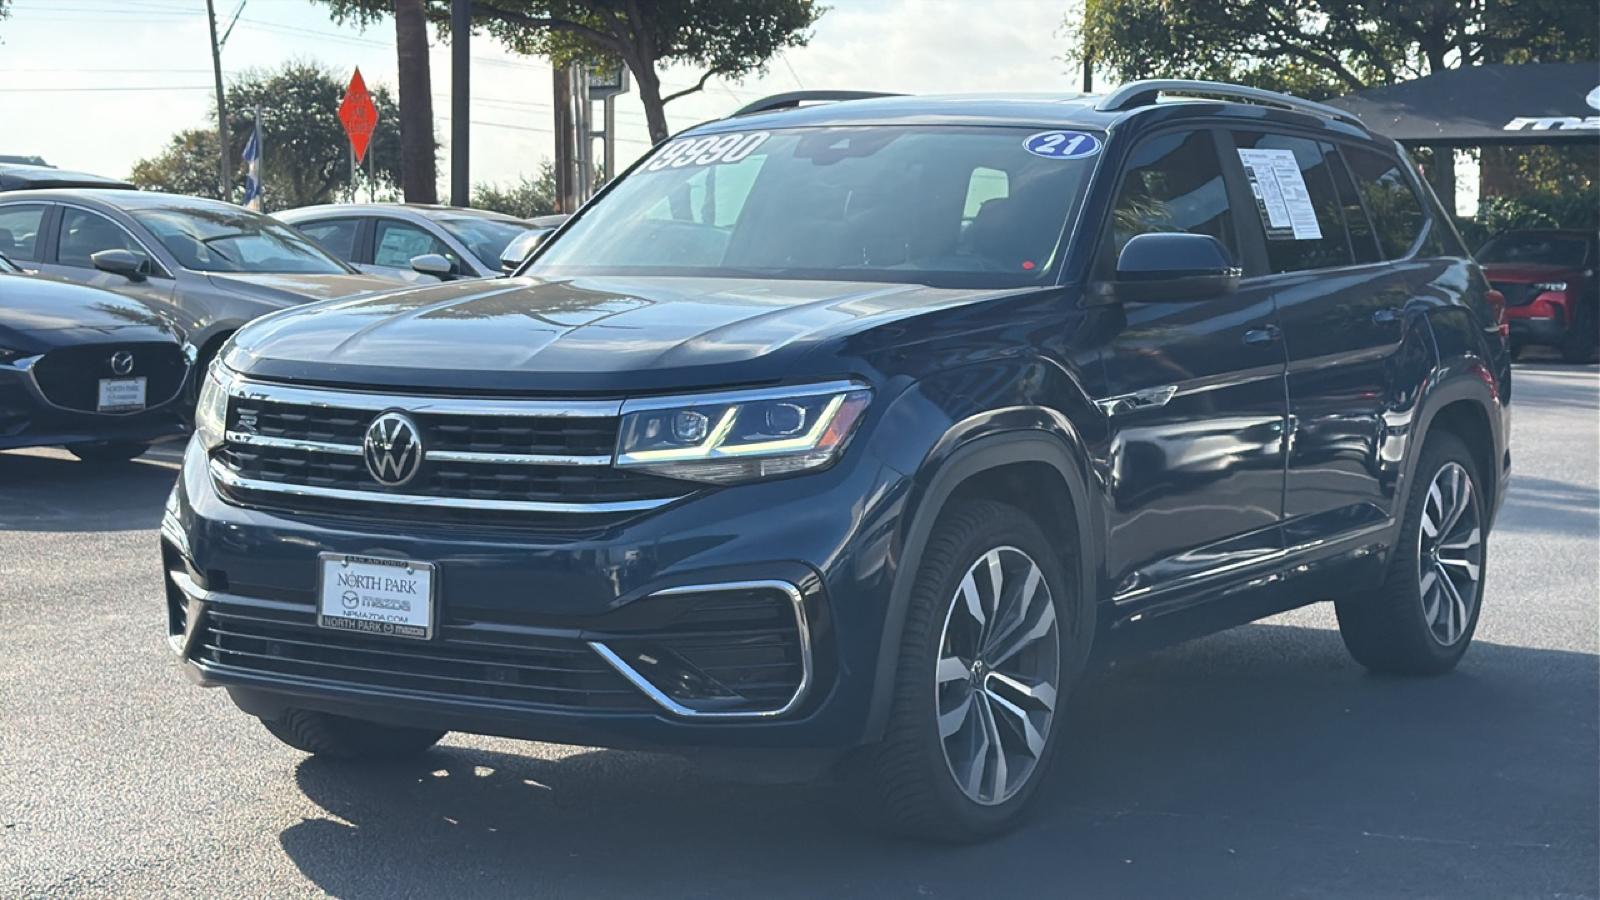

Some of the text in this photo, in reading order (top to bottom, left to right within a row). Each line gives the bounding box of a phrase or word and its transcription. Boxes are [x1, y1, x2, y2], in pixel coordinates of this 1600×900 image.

[631, 131, 770, 175] 19990
[1034, 134, 1086, 155] 21
[337, 572, 417, 594] NORTH PARK
[362, 596, 411, 611] mazda
[324, 616, 355, 629] NORTH
[358, 620, 382, 632] PARK
